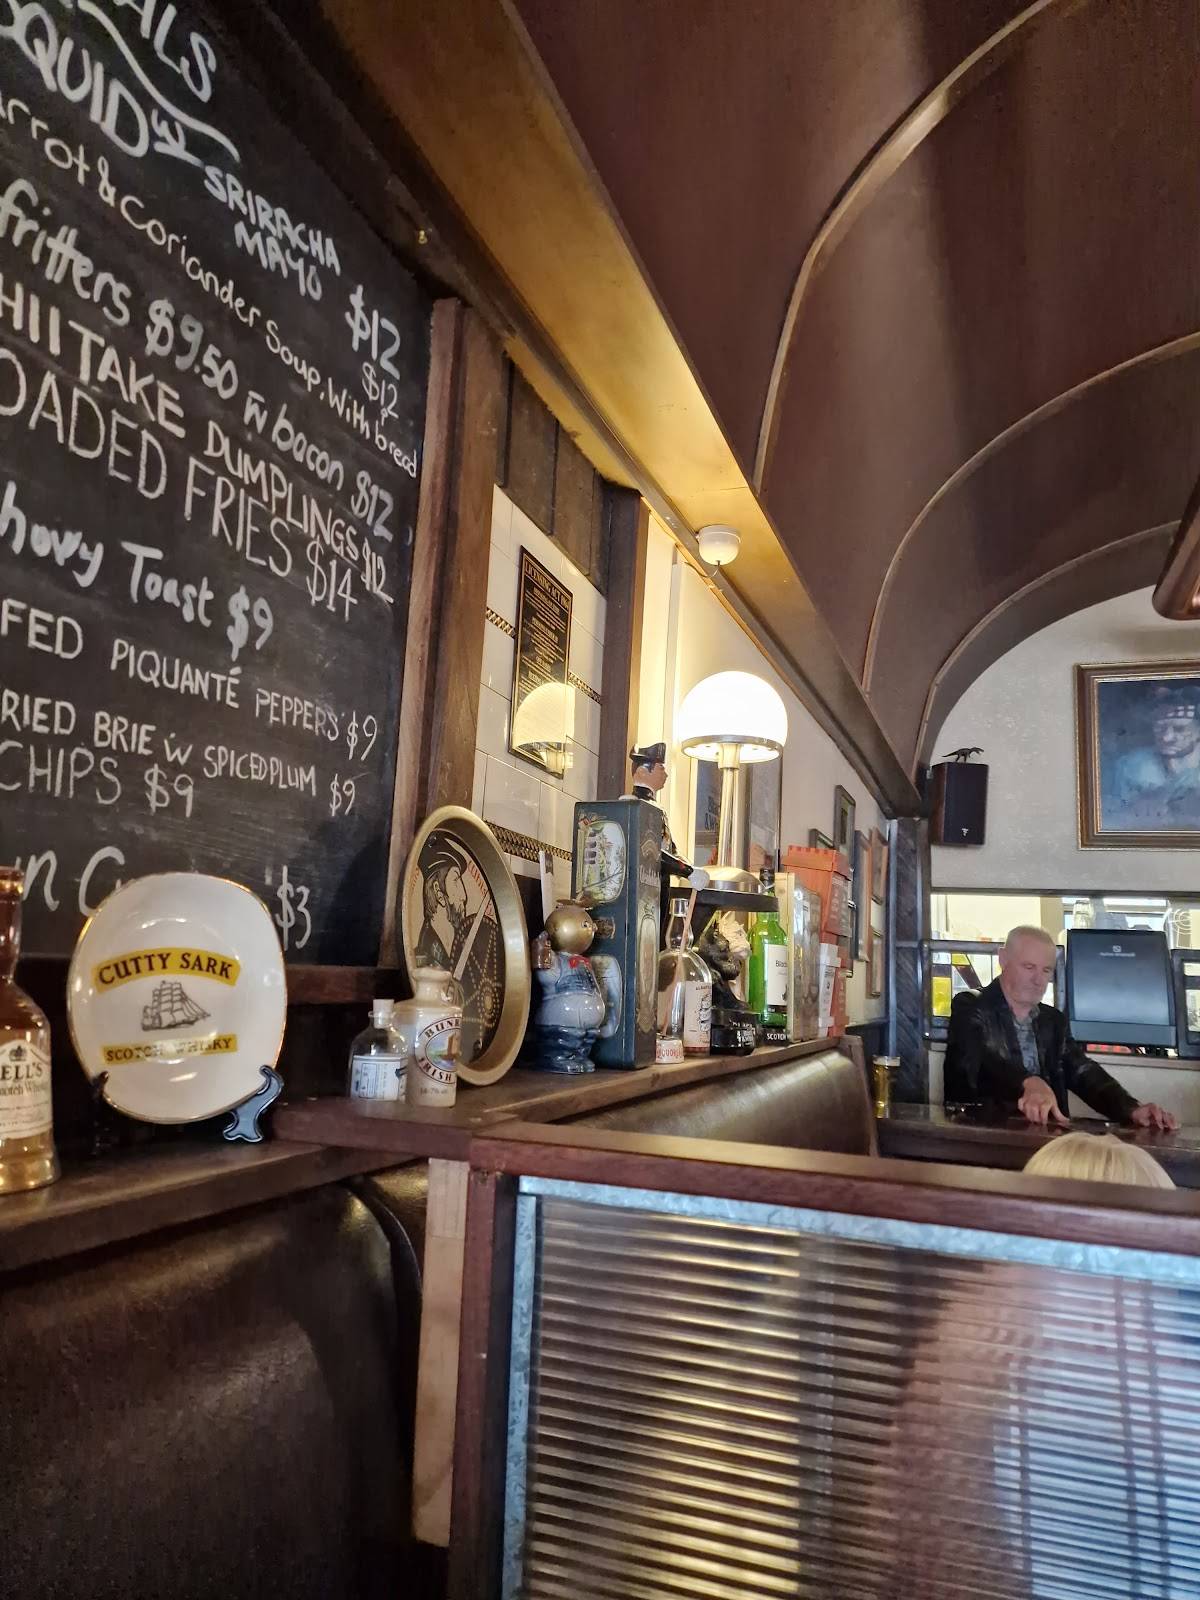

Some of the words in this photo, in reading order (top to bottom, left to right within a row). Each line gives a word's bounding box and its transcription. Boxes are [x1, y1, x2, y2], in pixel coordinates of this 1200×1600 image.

[0, 92, 90, 185] rrot
[362, 363, 399, 419] $12
[203, 165, 341, 276] SRIRACHA
[234, 222, 322, 300] MAYO
[345, 285, 401, 380] $12
[145, 298, 238, 398] $9.50
[271, 404, 344, 491] bacon
[351, 470, 394, 542] $12
[184, 457, 293, 577] FRIES
[306, 534, 358, 621] $14
[204, 420, 359, 563] DUMPLINGS
[121, 540, 214, 627] Toast
[227, 585, 274, 661] $9
[0, 739, 122, 805] CHIPS
[143, 763, 194, 817] $9
[94, 711, 157, 756] BRIE
[329, 774, 355, 817] $9
[346, 711, 378, 761] $9
[275, 866, 311, 951] $3
[98, 952, 171, 985] CUTTY
[179, 952, 234, 980] SARK
